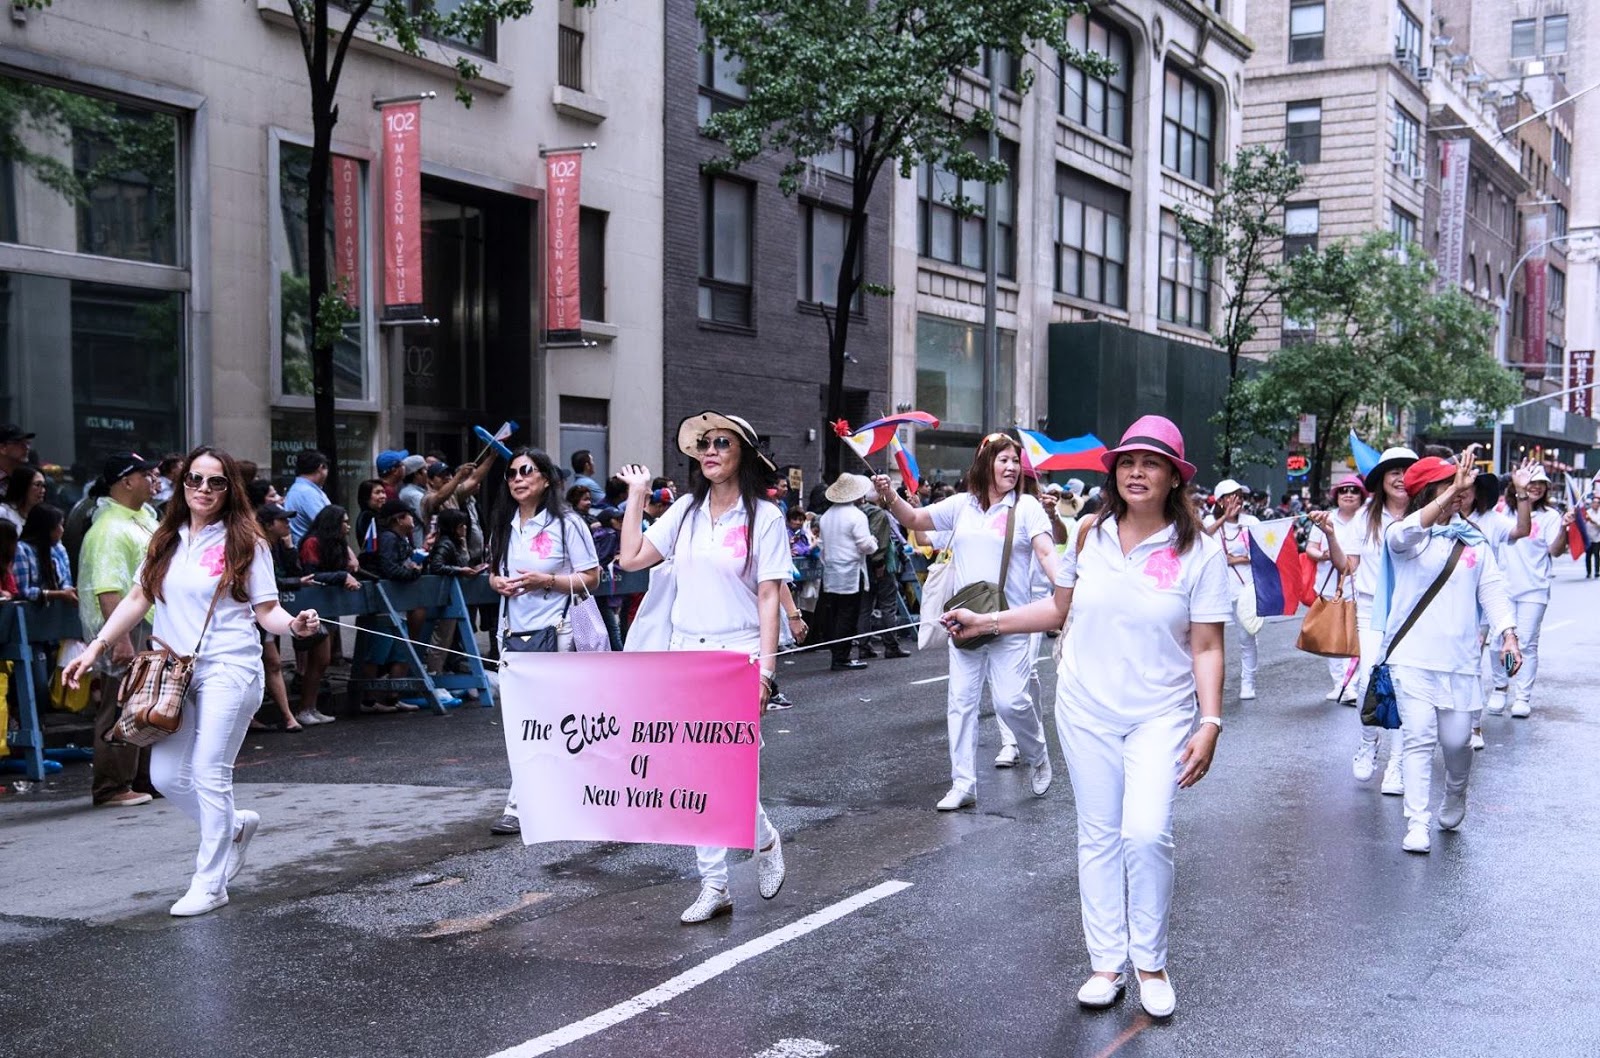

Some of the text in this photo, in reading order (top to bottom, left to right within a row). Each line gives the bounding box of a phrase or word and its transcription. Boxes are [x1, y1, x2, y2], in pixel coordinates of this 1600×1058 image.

[387, 112, 415, 132] 102
[550, 161, 576, 178] 102
[394, 143, 406, 302] MADISON AVENUE
[1449, 154, 1467, 281] AMERICAN ACADEMY
[555, 187, 566, 329] MADISON AVENUE
[521, 712, 756, 754] The Elite BABY NURSES
[630, 754, 651, 778] Of
[582, 785, 708, 815] New York City
